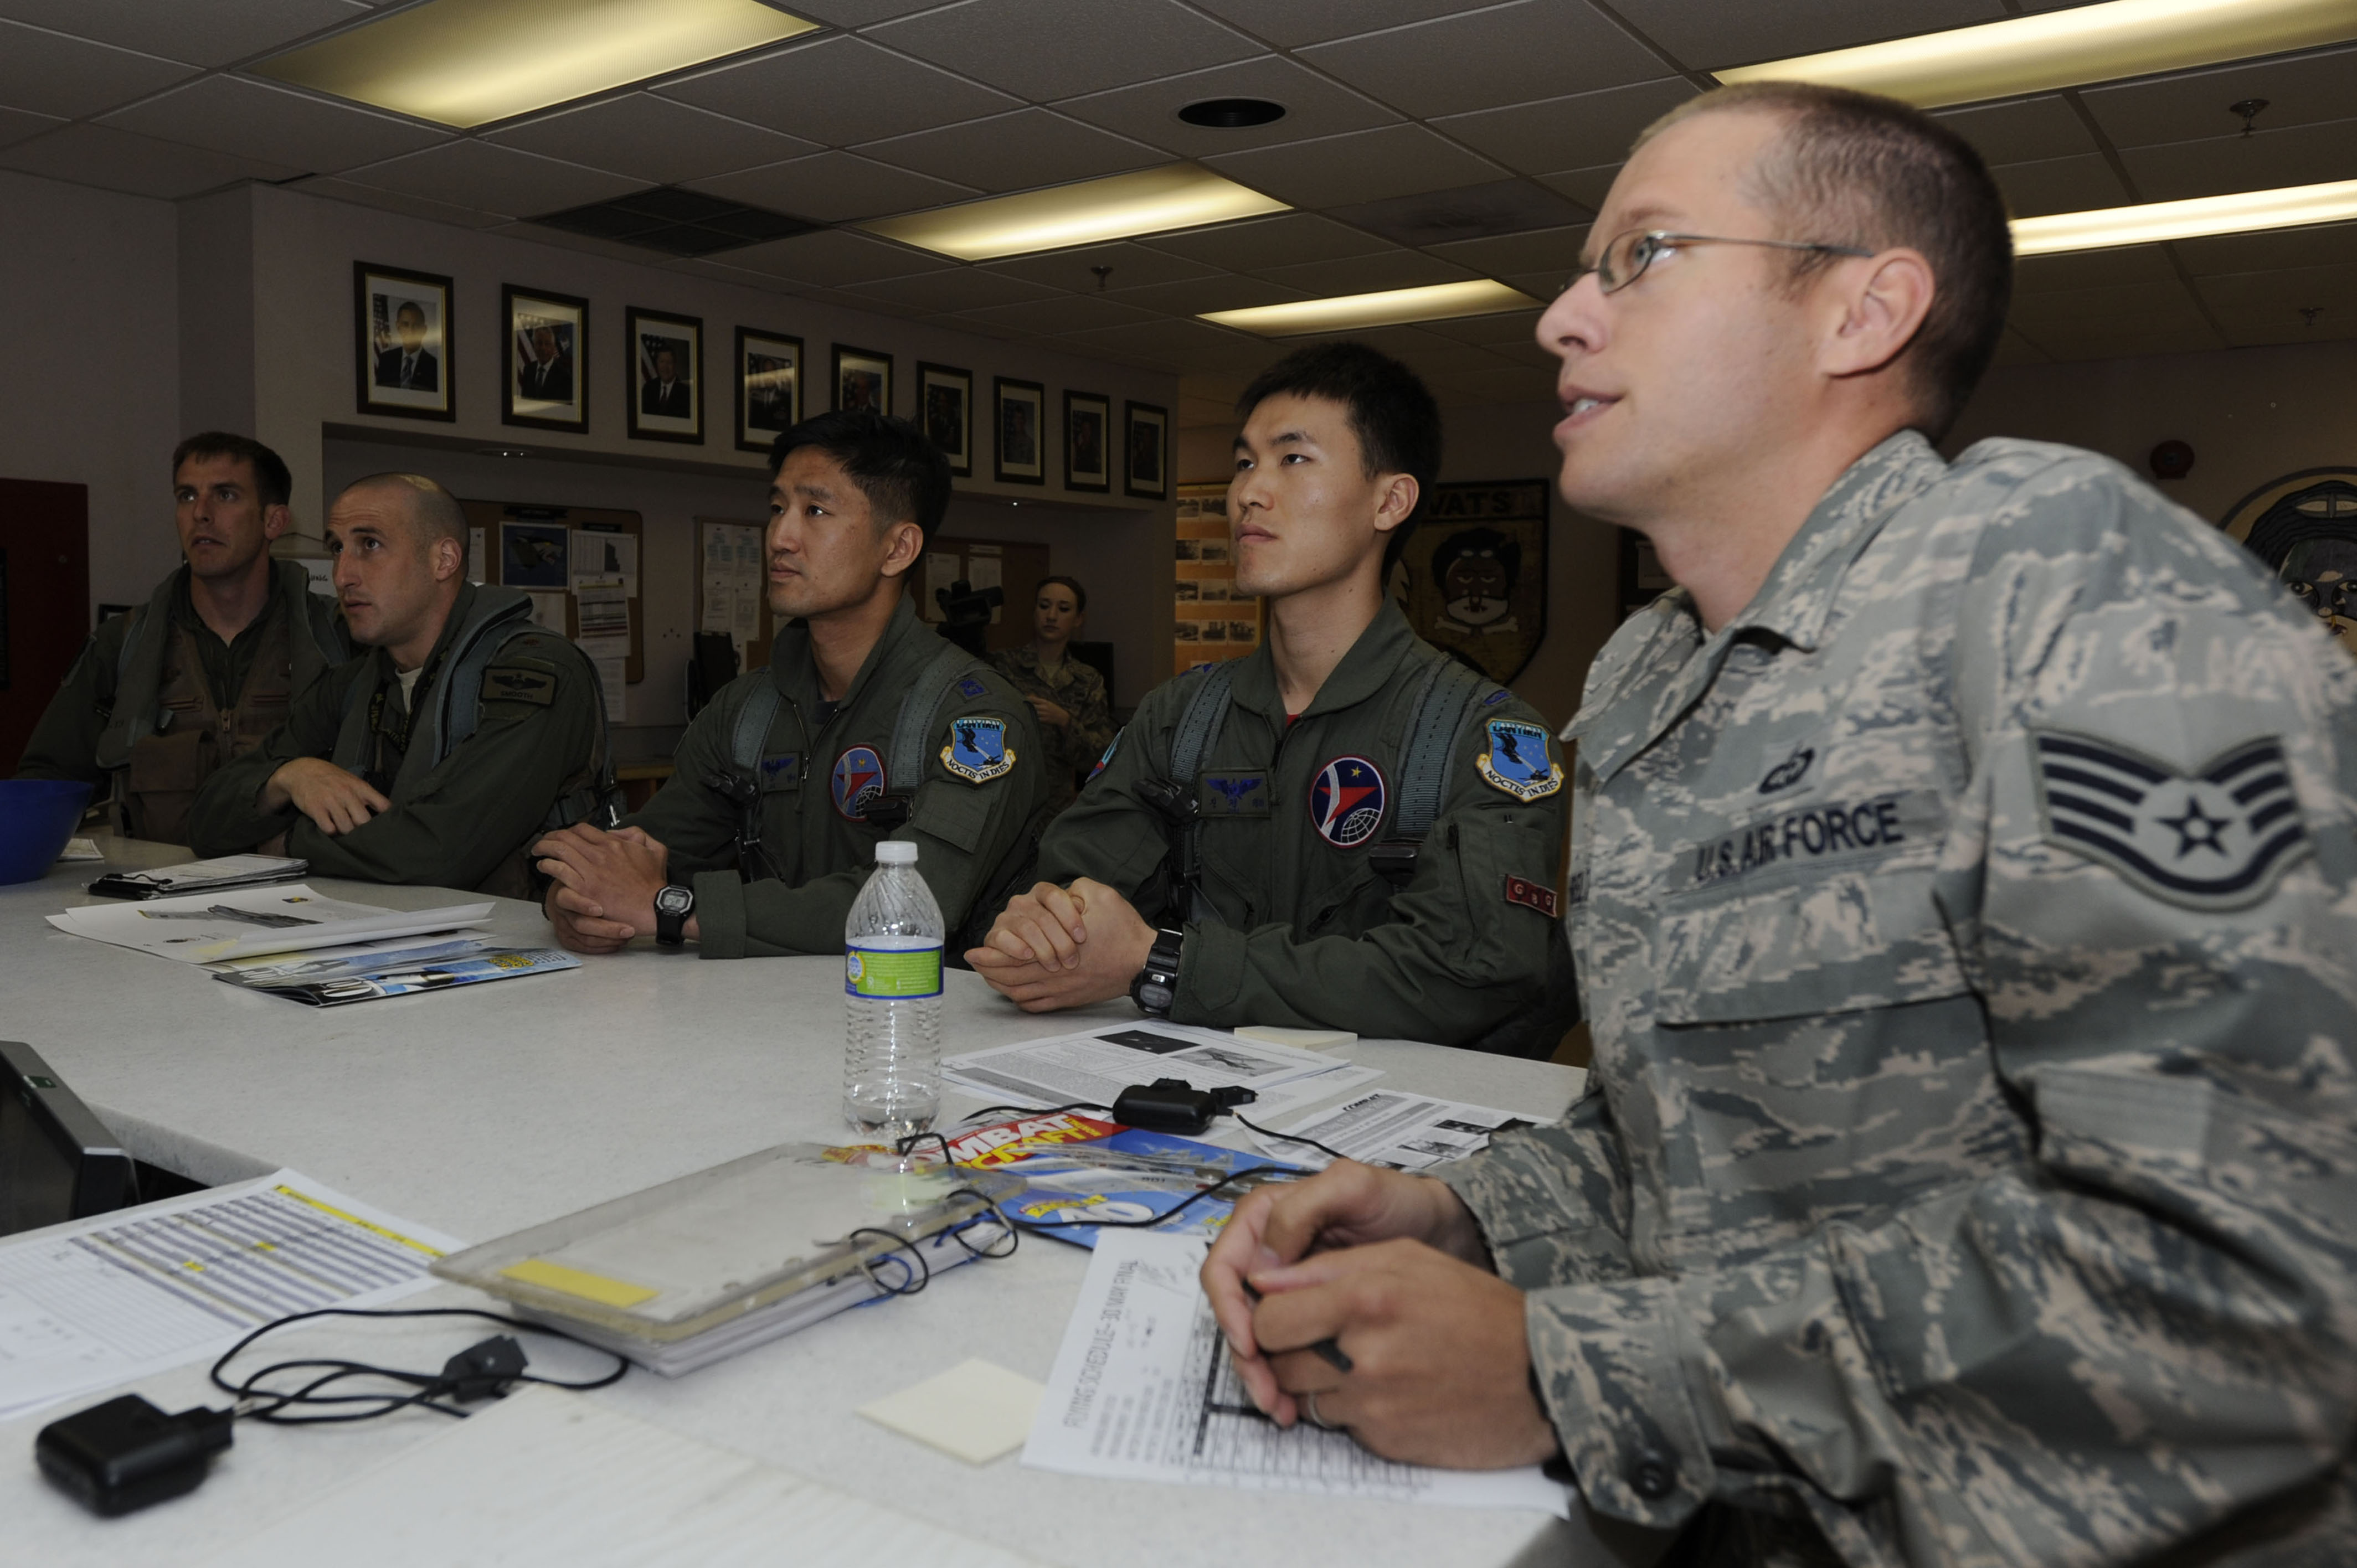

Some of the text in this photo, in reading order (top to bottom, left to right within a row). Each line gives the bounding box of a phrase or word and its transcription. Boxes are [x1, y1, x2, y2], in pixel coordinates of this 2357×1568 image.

[500, 690, 533, 700] SMOOTH
[947, 759, 1010, 780] NOCTIS IN DIES
[1487, 770, 1524, 795] NOCTIS
[1527, 786, 1541, 797] IN
[1741, 825, 1778, 873] AIR
[1783, 802, 1906, 860] FORCE
[950, 1126, 1088, 1172] CRAFT
